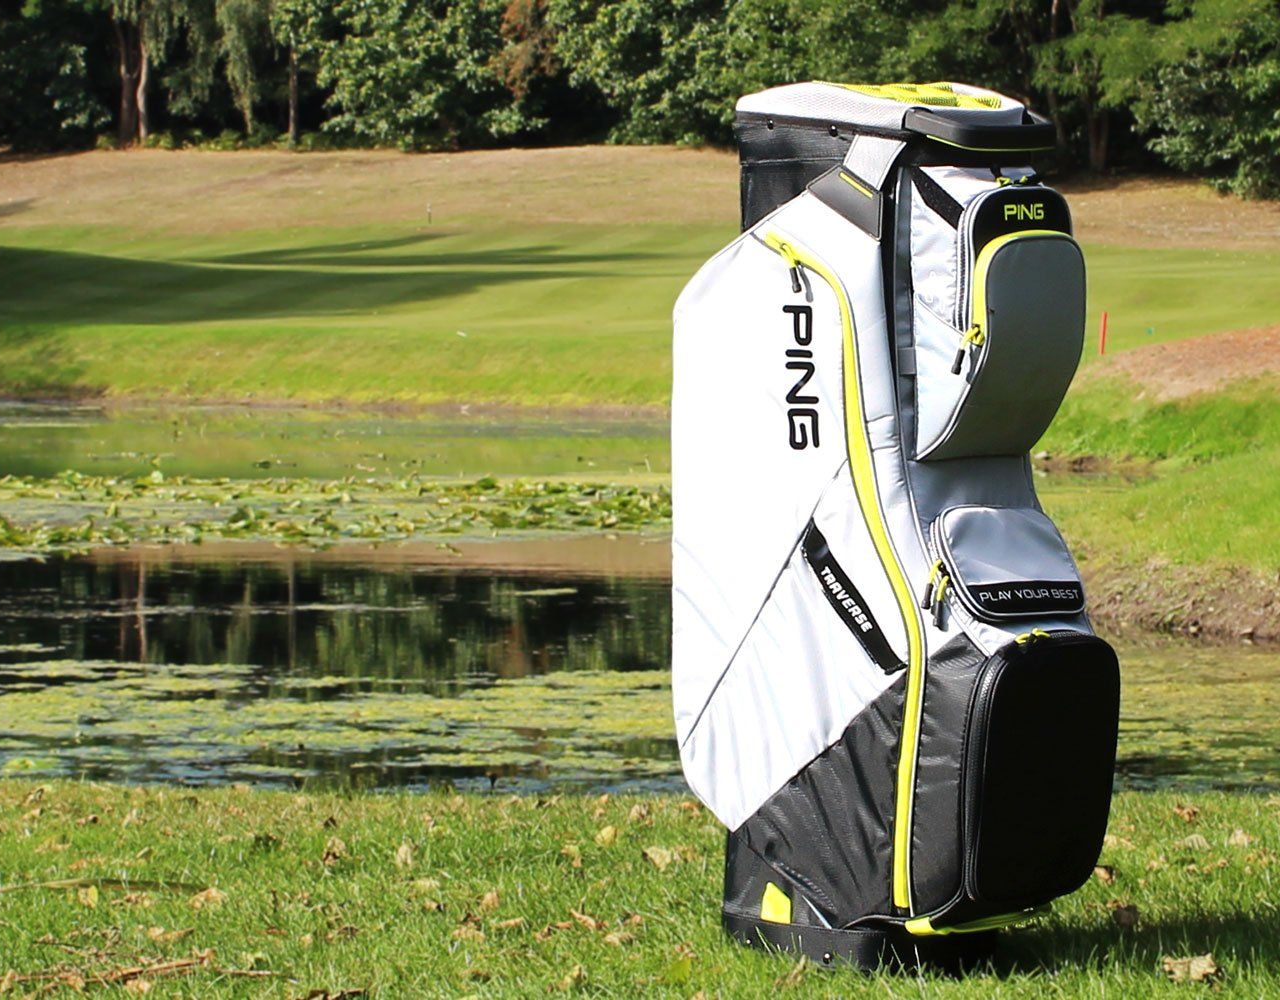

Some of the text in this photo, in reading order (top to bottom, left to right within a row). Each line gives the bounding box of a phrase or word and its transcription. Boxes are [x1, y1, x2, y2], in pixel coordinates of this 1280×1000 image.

[1004, 203, 1045, 221] PING
[782, 304, 820, 450] PING
[820, 565, 874, 633] TRAVERSE
[979, 588, 1079, 602] PLAY YOUR BEST
